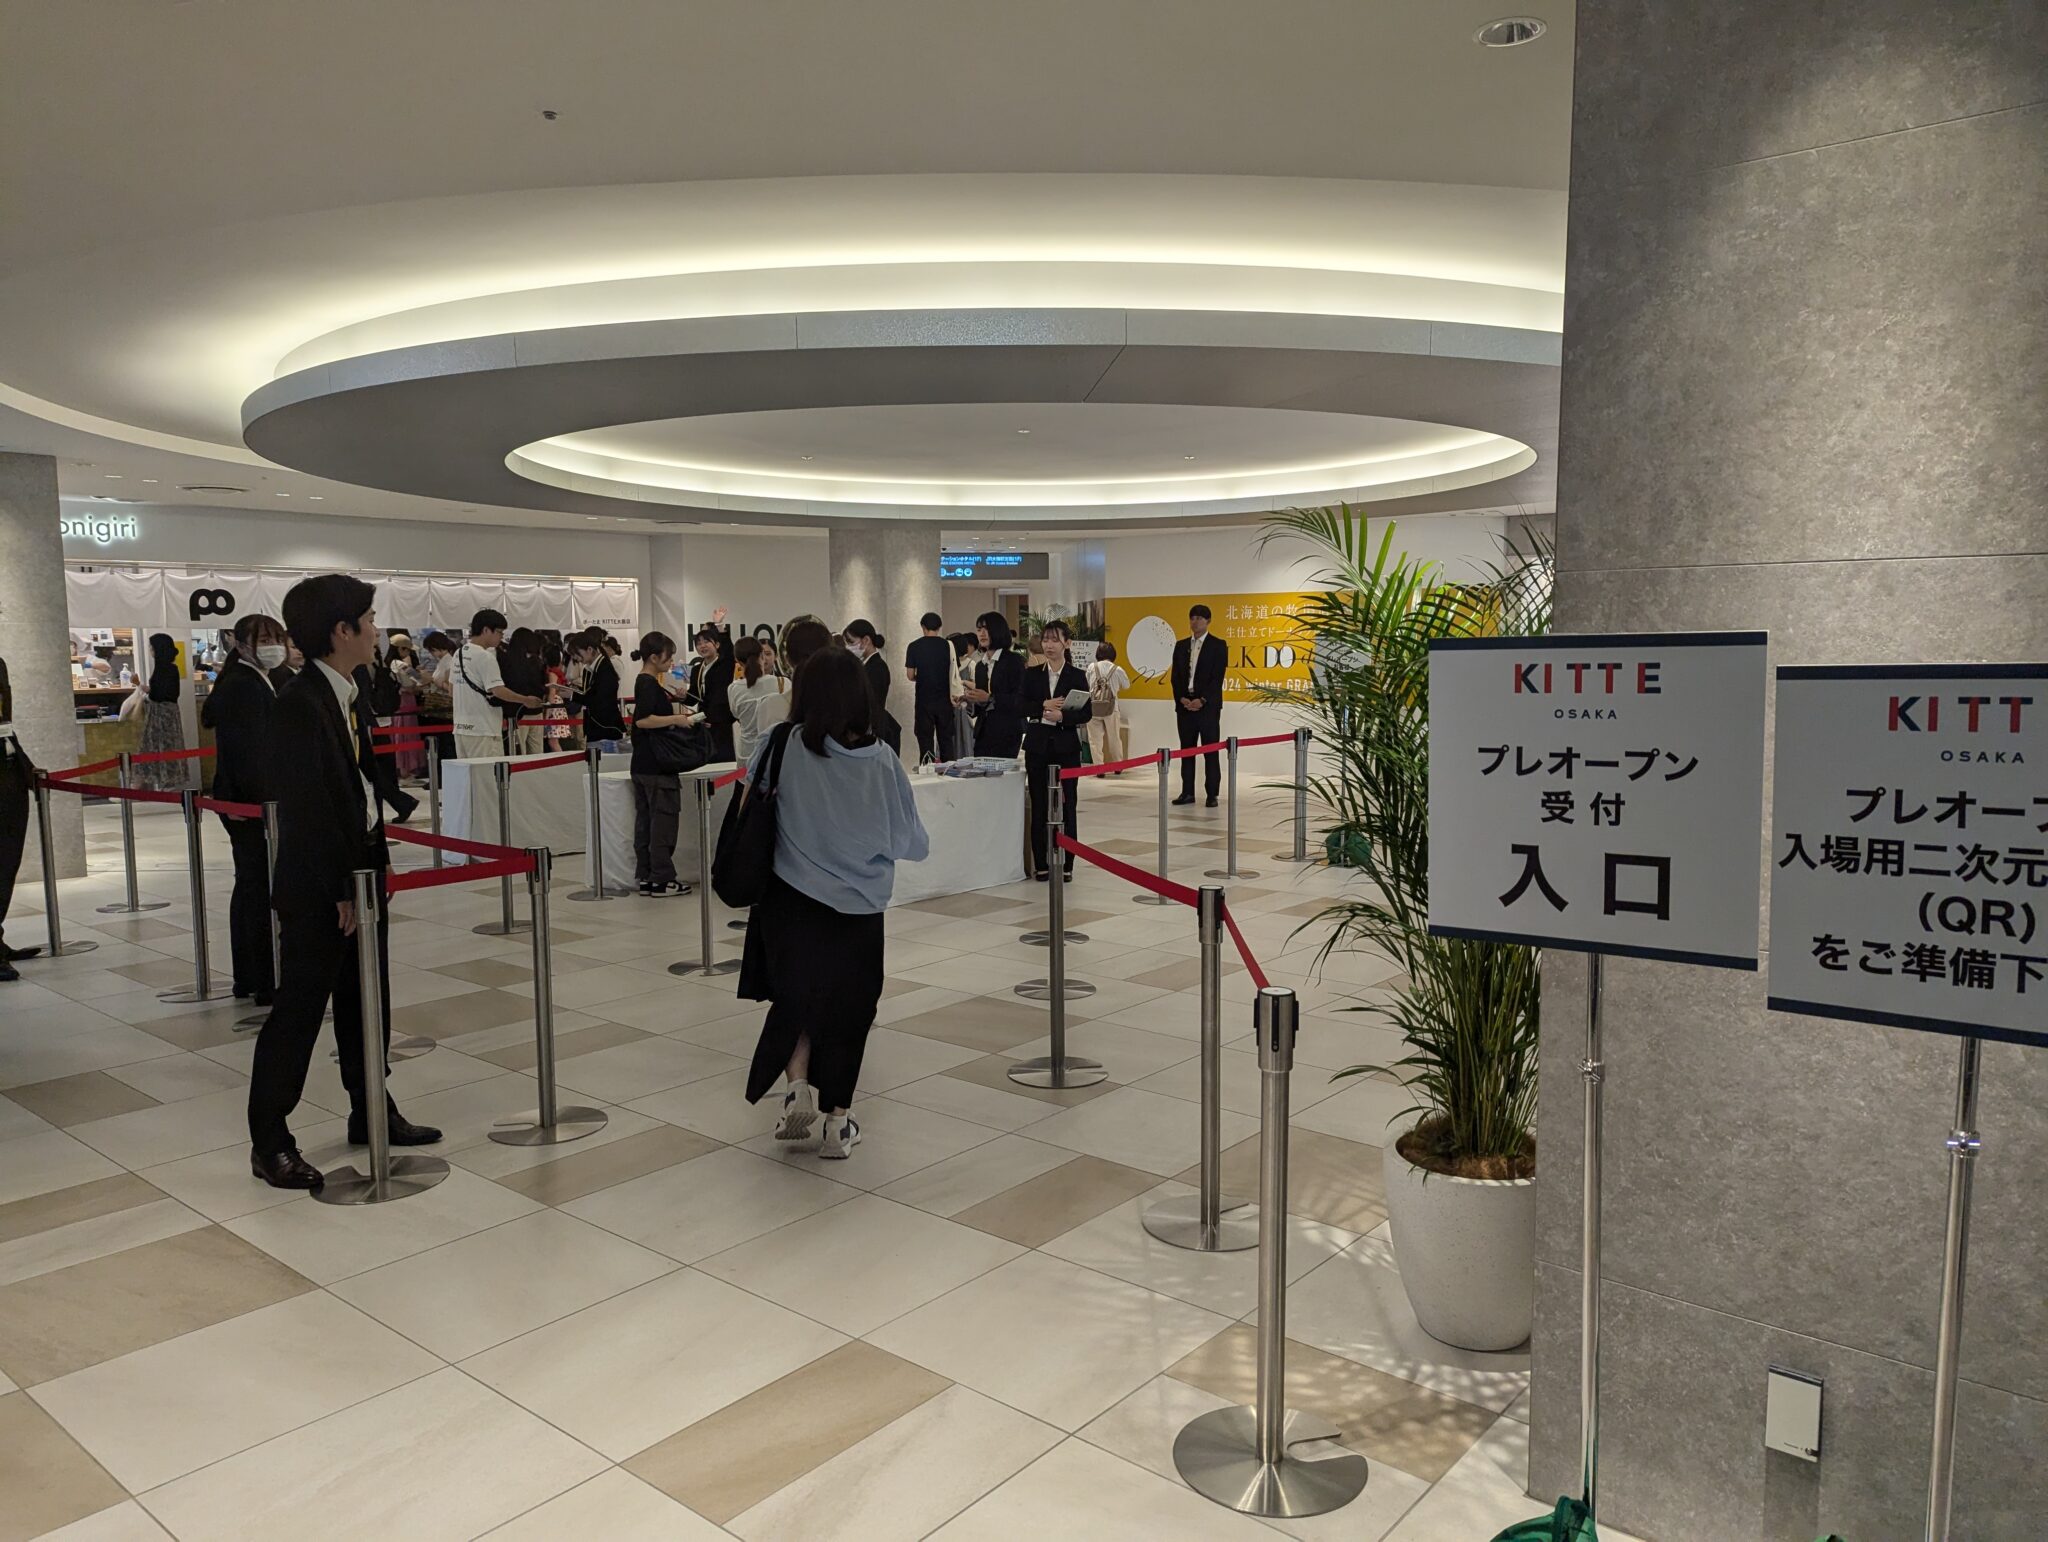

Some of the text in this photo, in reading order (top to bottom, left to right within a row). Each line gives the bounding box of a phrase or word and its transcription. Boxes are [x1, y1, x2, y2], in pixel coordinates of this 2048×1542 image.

[60, 514, 136, 543] onigiri
[1221, 678, 1241, 692] 024
[1514, 662, 1662, 694] KITTE
[1554, 708, 1618, 720] OSAKA
[1478, 744, 1699, 782] プレオープン
[1941, 750, 2025, 764] OSAKA
[1541, 790, 1626, 827] 受付
[1778, 833, 2048, 888] 入場用二次元
[1498, 843, 1672, 921] 入口
[1919, 892, 2036, 945] (QR)
[1812, 934, 2048, 993] をご準備下
